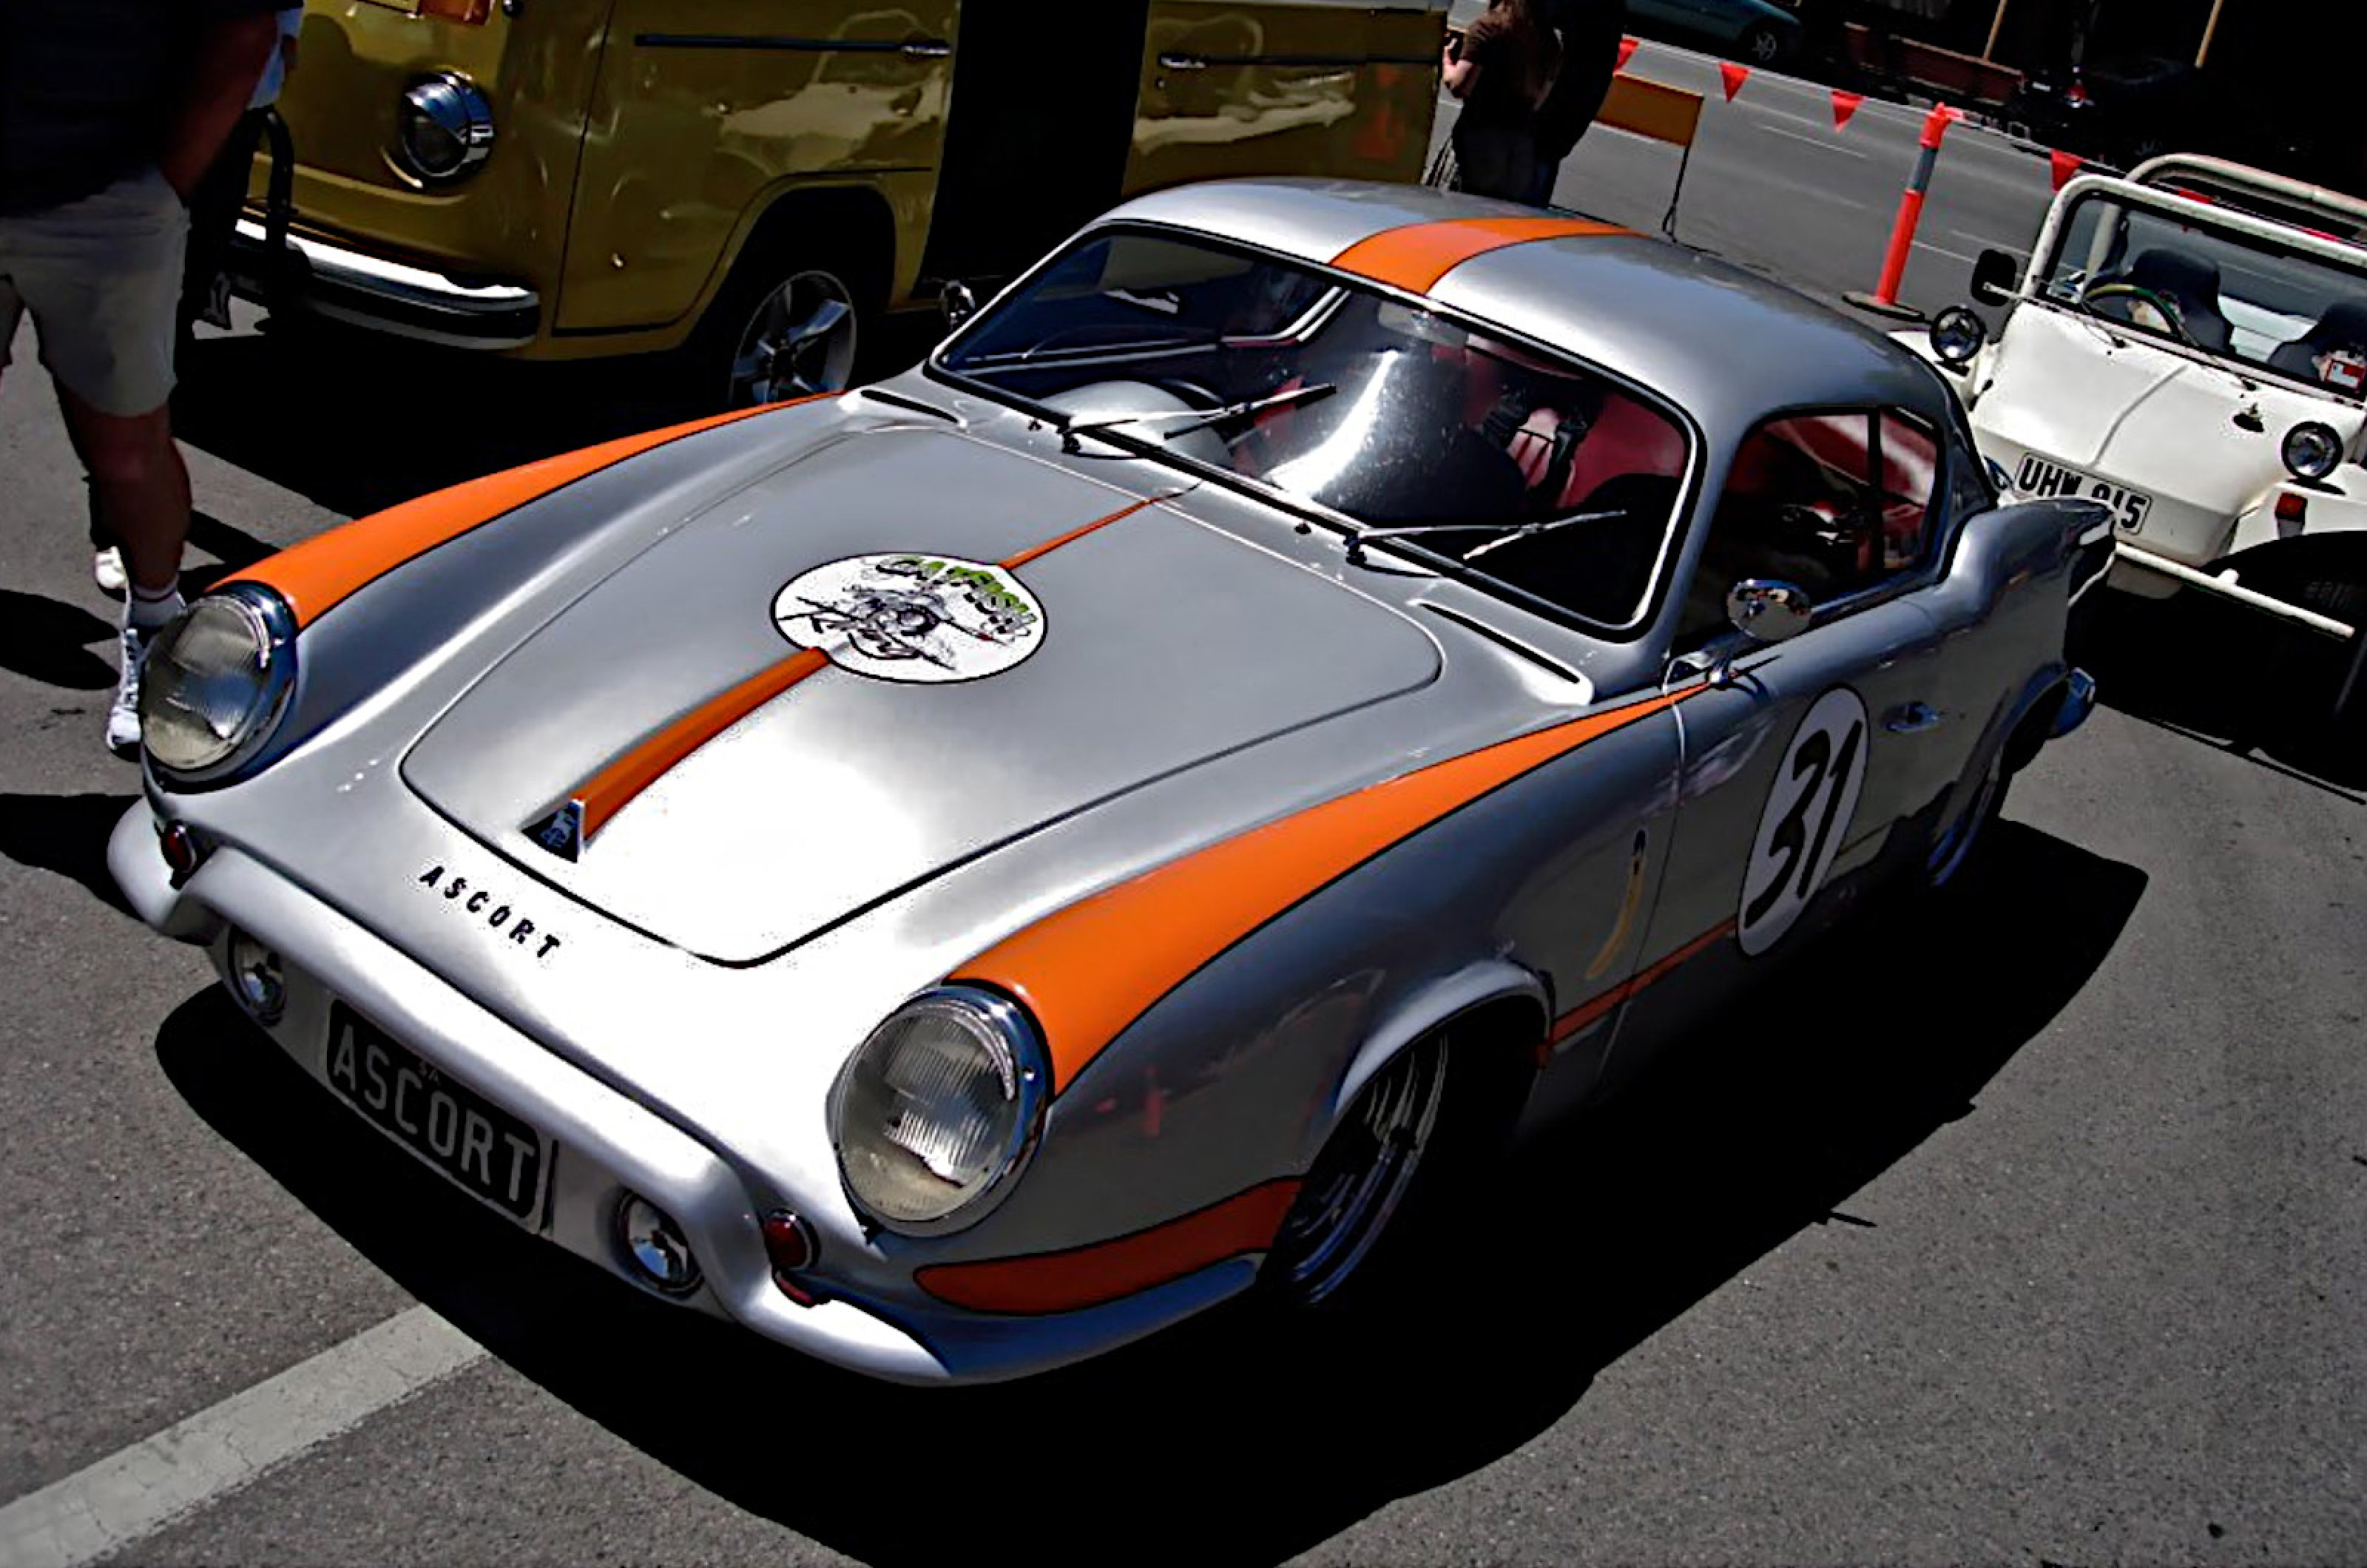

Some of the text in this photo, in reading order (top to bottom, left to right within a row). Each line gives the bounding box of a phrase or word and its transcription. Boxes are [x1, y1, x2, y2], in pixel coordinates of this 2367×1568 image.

[2019, 458, 2082, 496] UHW
[1743, 719, 1863, 929] 31
[419, 866, 561, 959] ASCORT
[333, 1024, 535, 1202] ASCORT
